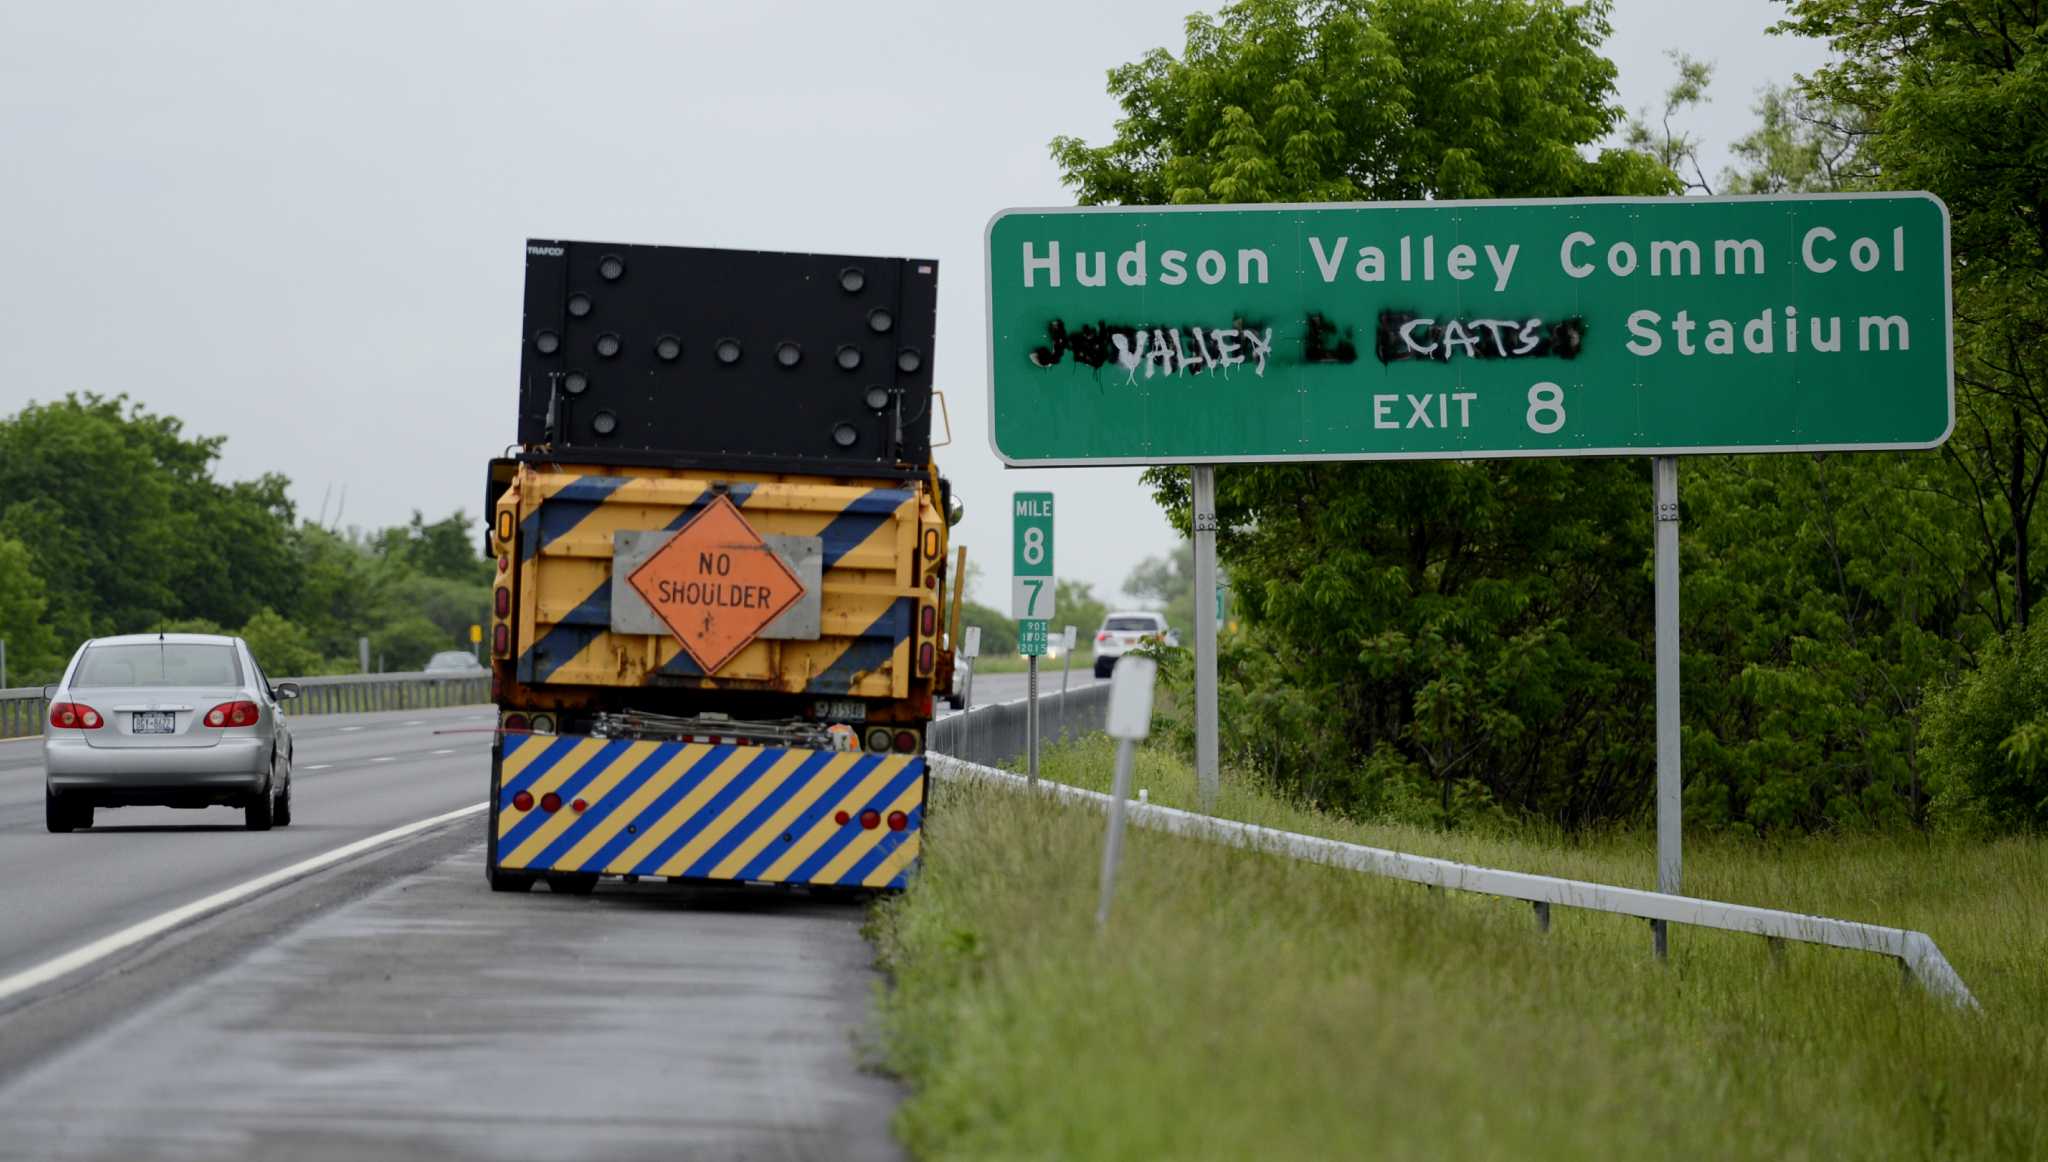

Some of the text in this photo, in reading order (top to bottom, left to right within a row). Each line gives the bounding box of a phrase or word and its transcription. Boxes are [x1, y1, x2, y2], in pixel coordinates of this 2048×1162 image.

[1023, 226, 1904, 292] Hudson Valley Comm Col
[1112, 327, 1272, 380] VALLEY
[1400, 318, 1541, 359] CATS
[1626, 306, 1910, 356] Stadium
[1373, 382, 1566, 434] EXIT 8
[1016, 501, 1052, 517] MILE
[699, 552, 730, 577] NO
[1023, 527, 1045, 566] 8
[658, 580, 771, 609] SHOULDER
[1023, 580, 1043, 616] 7
